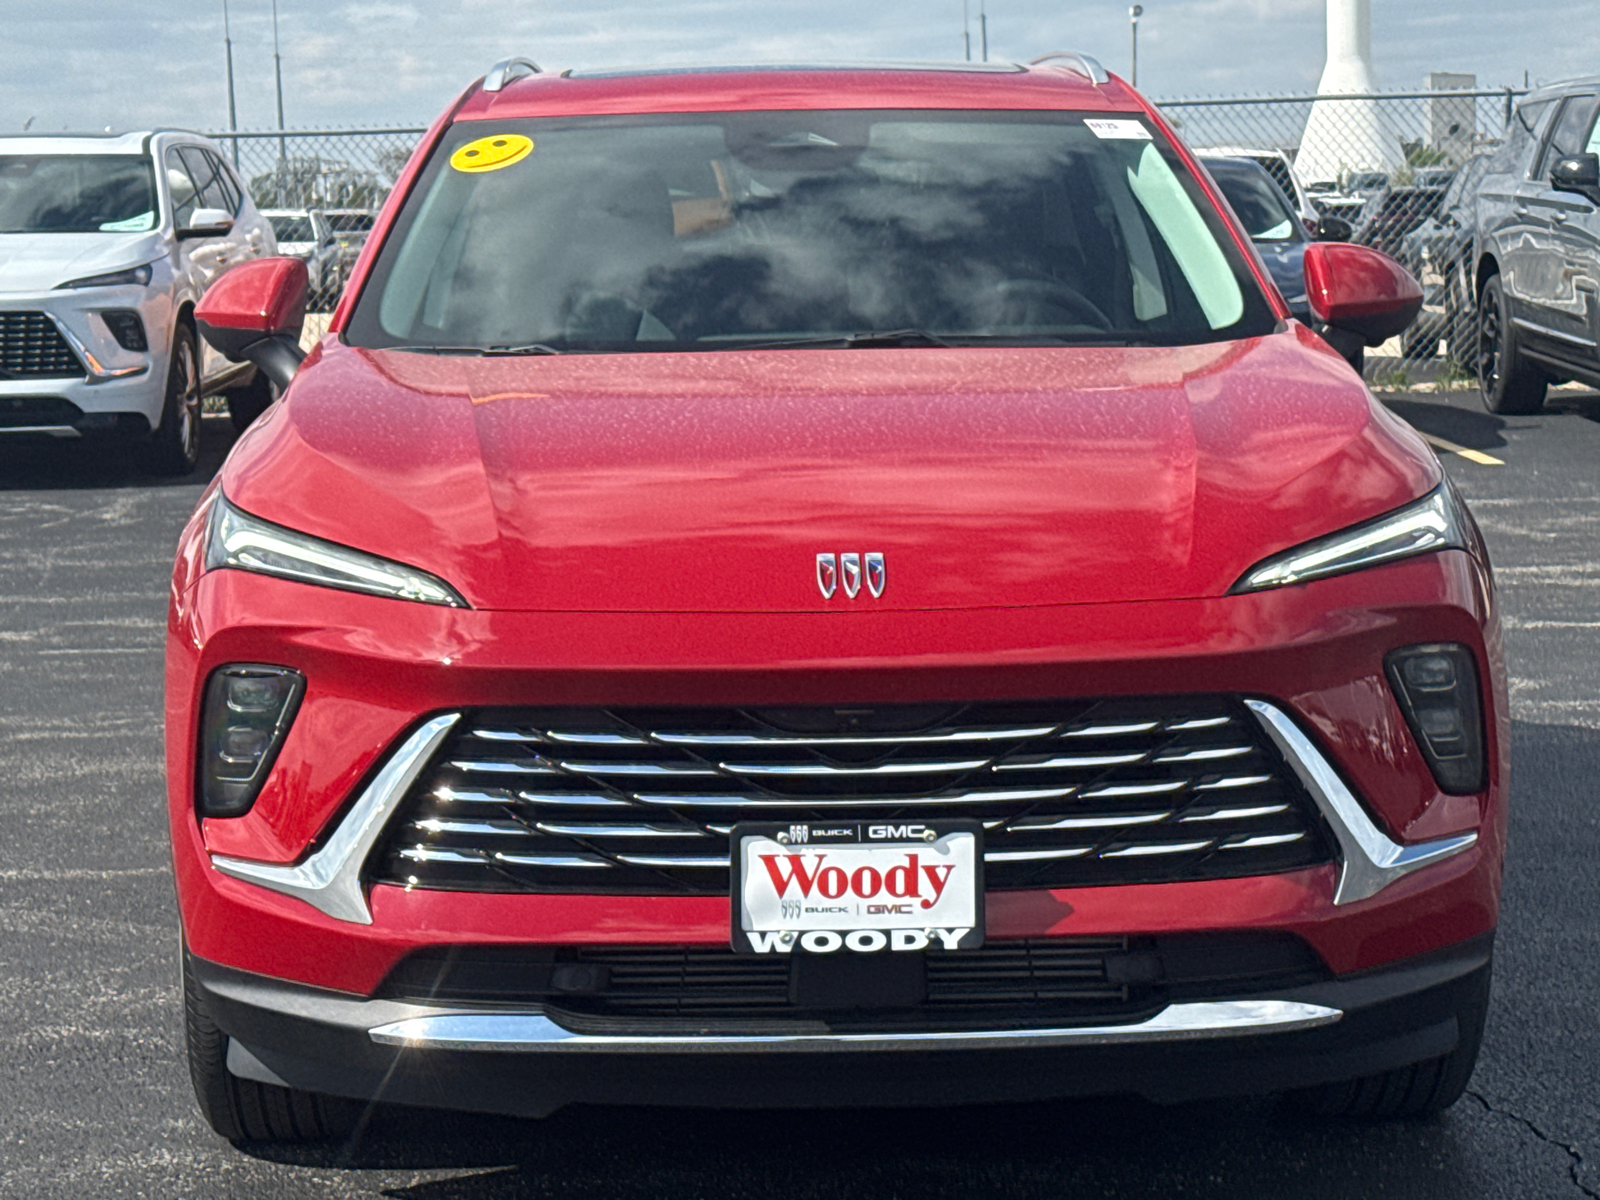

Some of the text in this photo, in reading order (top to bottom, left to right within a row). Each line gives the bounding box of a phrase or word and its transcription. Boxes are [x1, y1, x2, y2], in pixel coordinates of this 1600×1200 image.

[812, 825, 926, 839] BUICK GMC
[758, 853, 956, 910] Woody
[804, 904, 913, 915] BUICK GMC
[746, 928, 970, 953] WOODY
